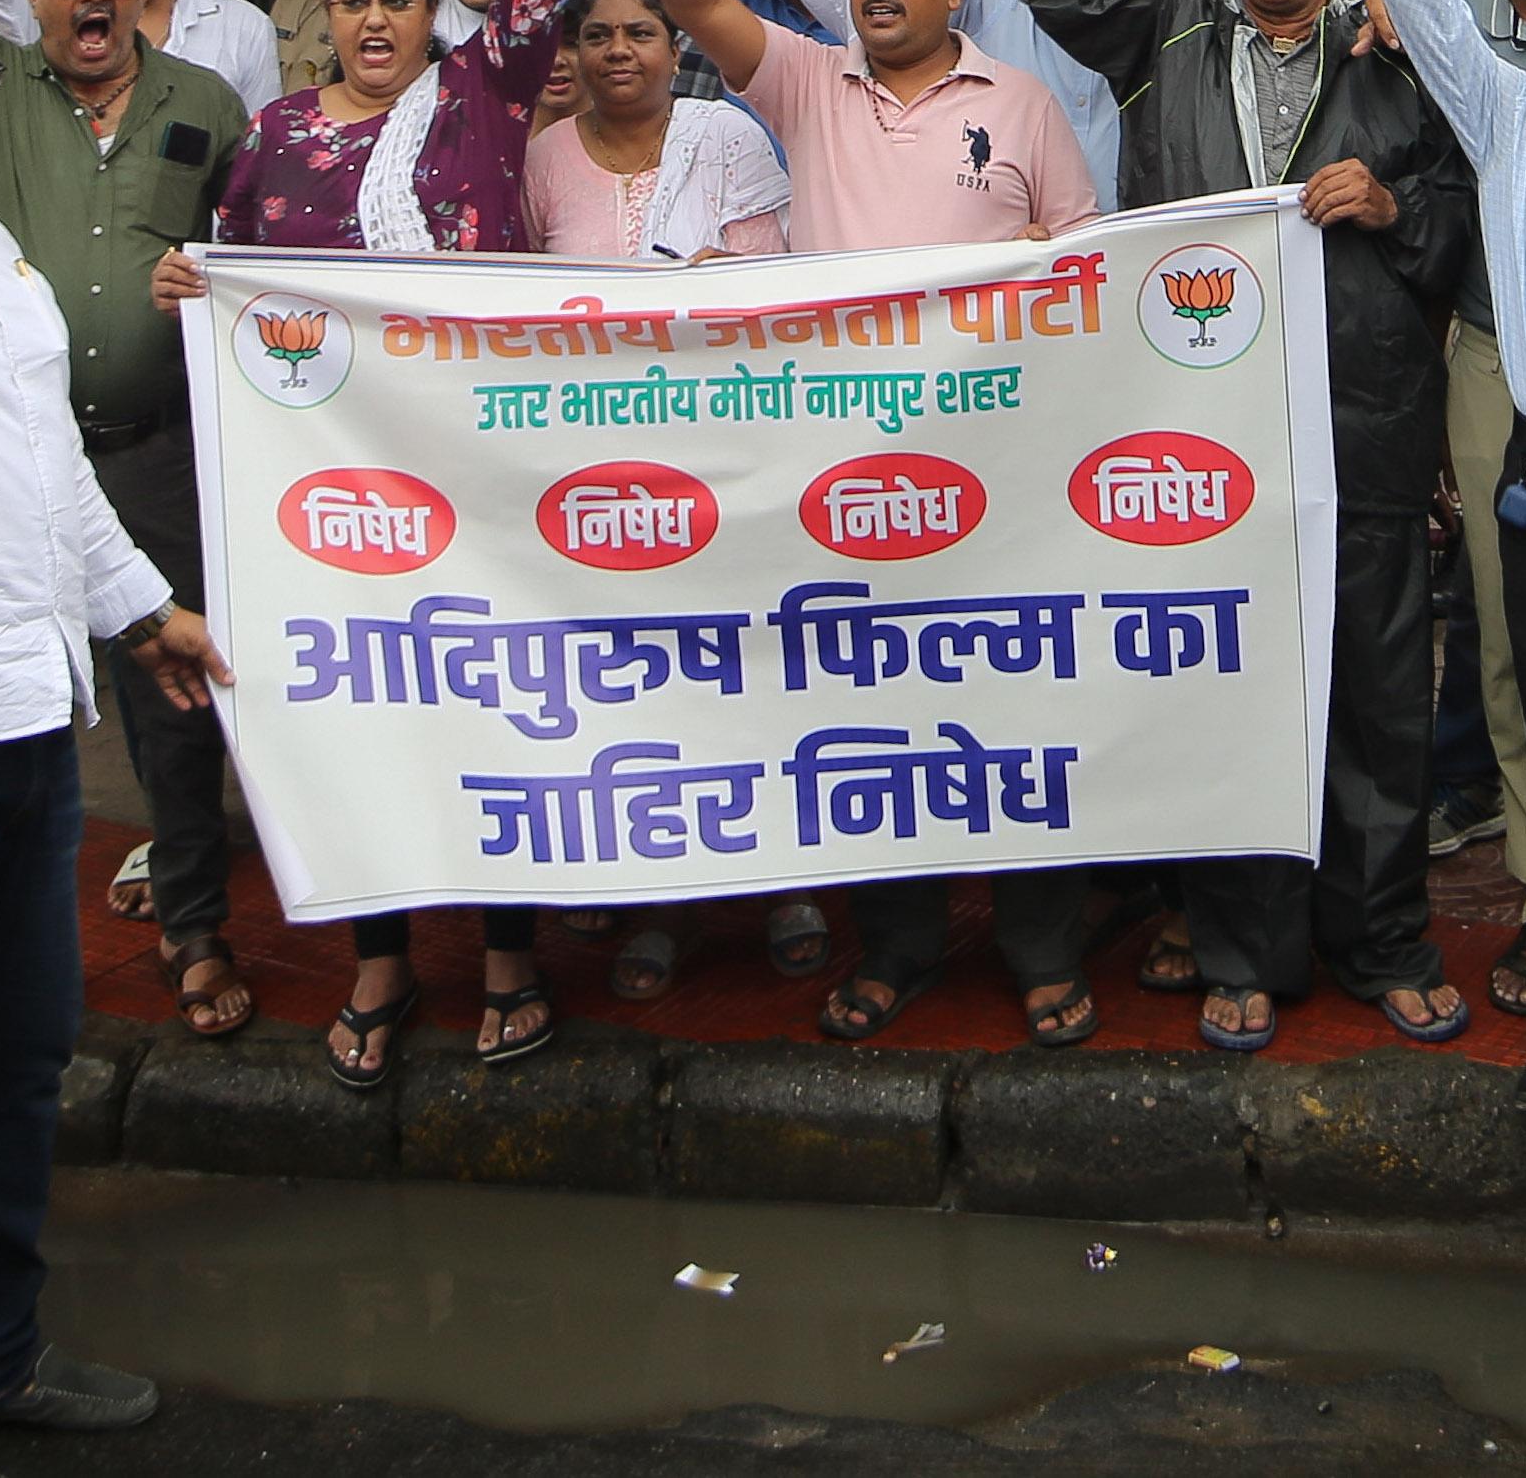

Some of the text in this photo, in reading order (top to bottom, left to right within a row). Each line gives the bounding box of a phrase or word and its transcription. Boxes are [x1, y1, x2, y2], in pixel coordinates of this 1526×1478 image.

[380, 251, 1109, 361] भारतीय जनता पार्टी
[473, 360, 1023, 433] उत्तर भारतीय मोर्चा नागपुर शहर
[301, 484, 431, 555] निषेध
[559, 482, 695, 549] निषेध
[822, 473, 961, 545] निषेध
[1092, 452, 1230, 529] निषेध
[285, 581, 1249, 740] आदिपुरुष फिल्म का
[460, 721, 1080, 864] जाहिर निषेध
